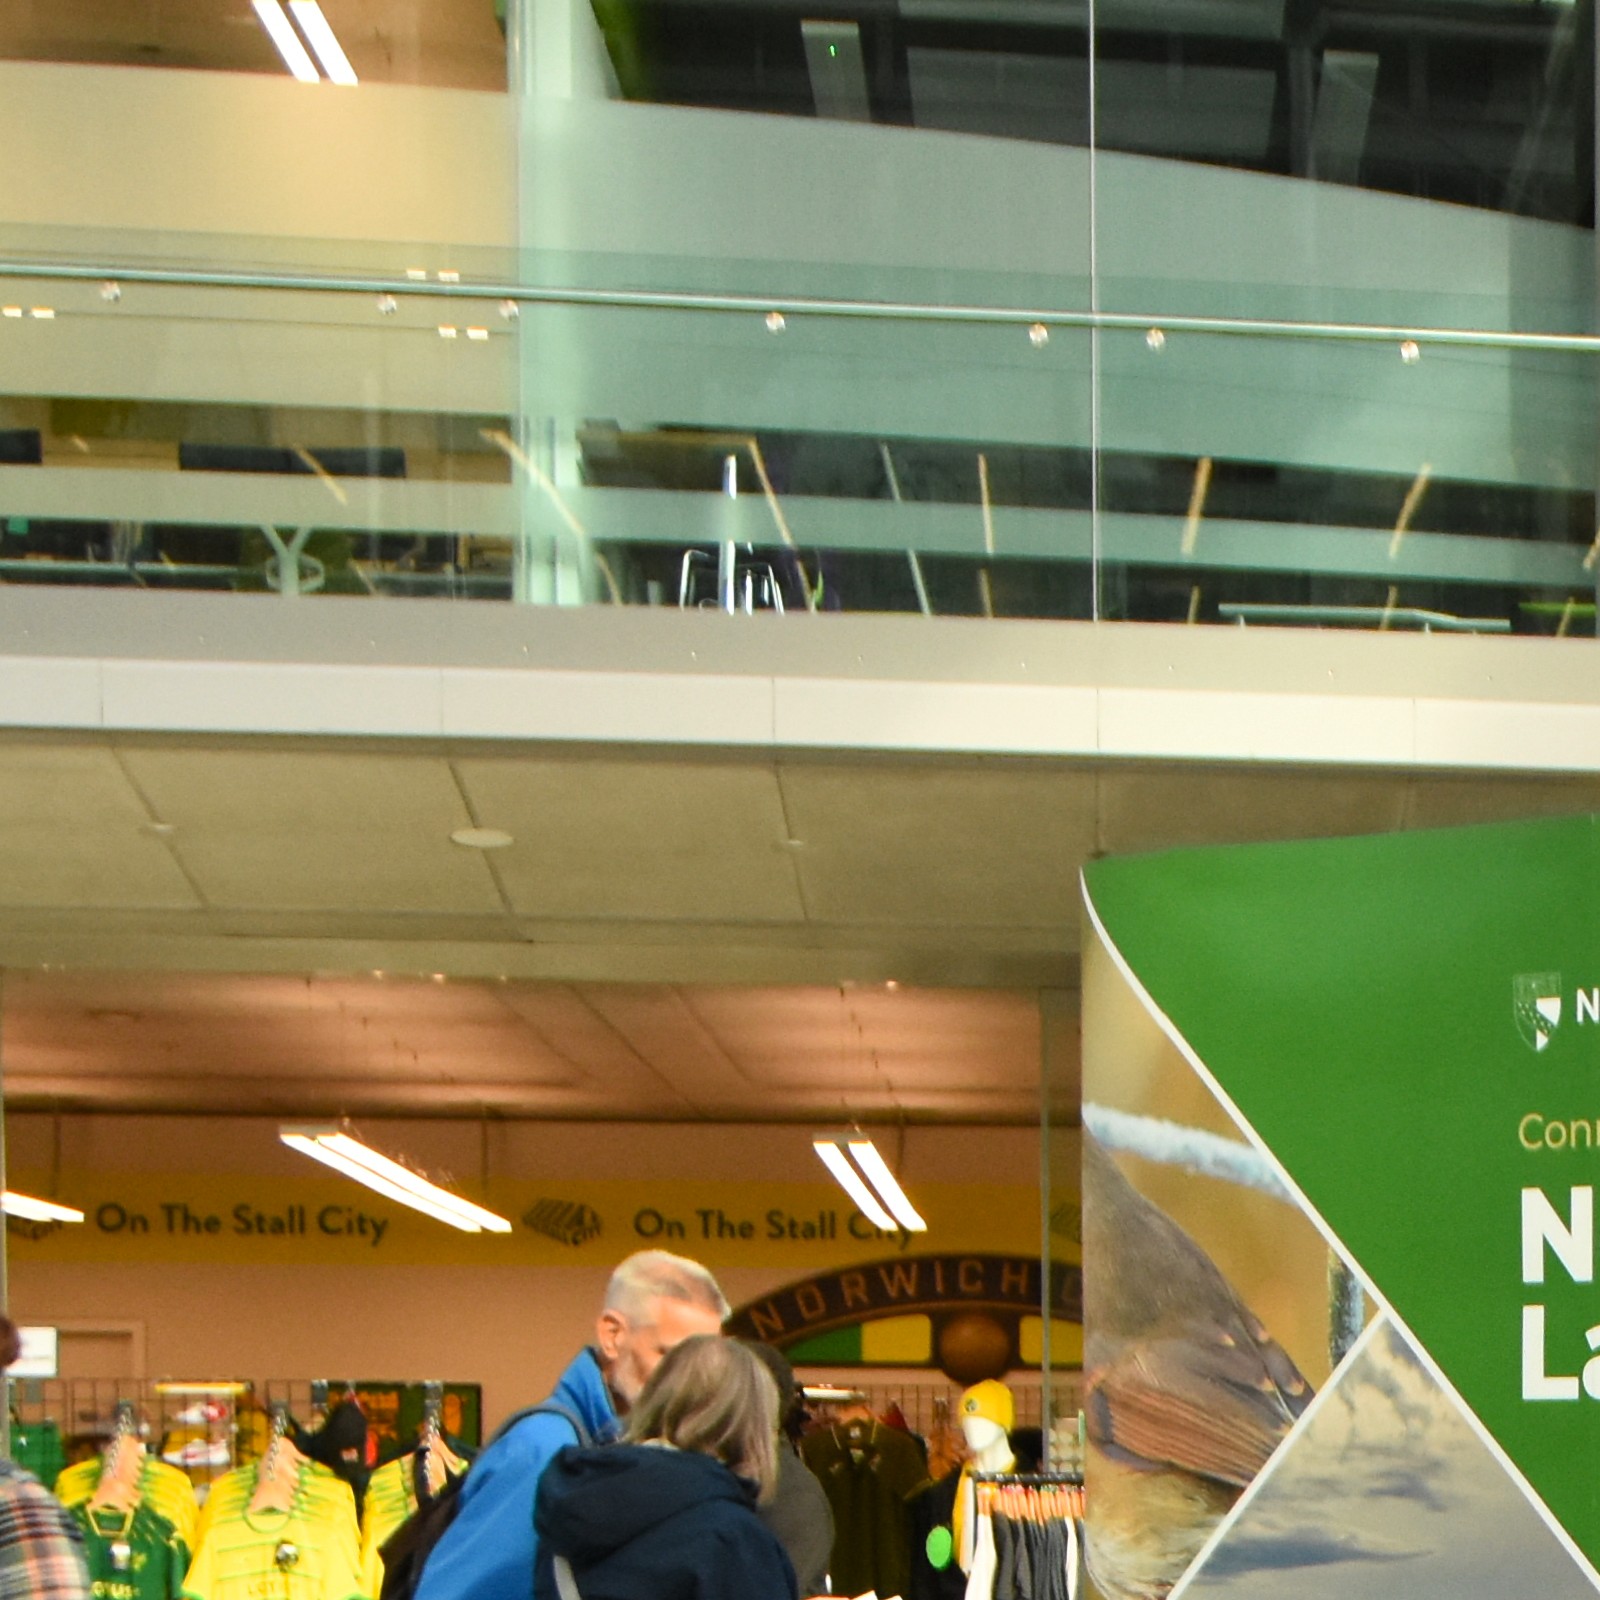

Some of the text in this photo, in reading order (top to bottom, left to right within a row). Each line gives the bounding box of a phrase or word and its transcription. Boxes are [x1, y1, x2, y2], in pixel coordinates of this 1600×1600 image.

[97, 1204, 388, 1247] On The Stall City
[634, 1208, 686, 1238] On
[696, 1209, 756, 1239] The
[766, 1210, 835, 1240] Stall
[751, 1260, 1029, 1339] NORWICH
